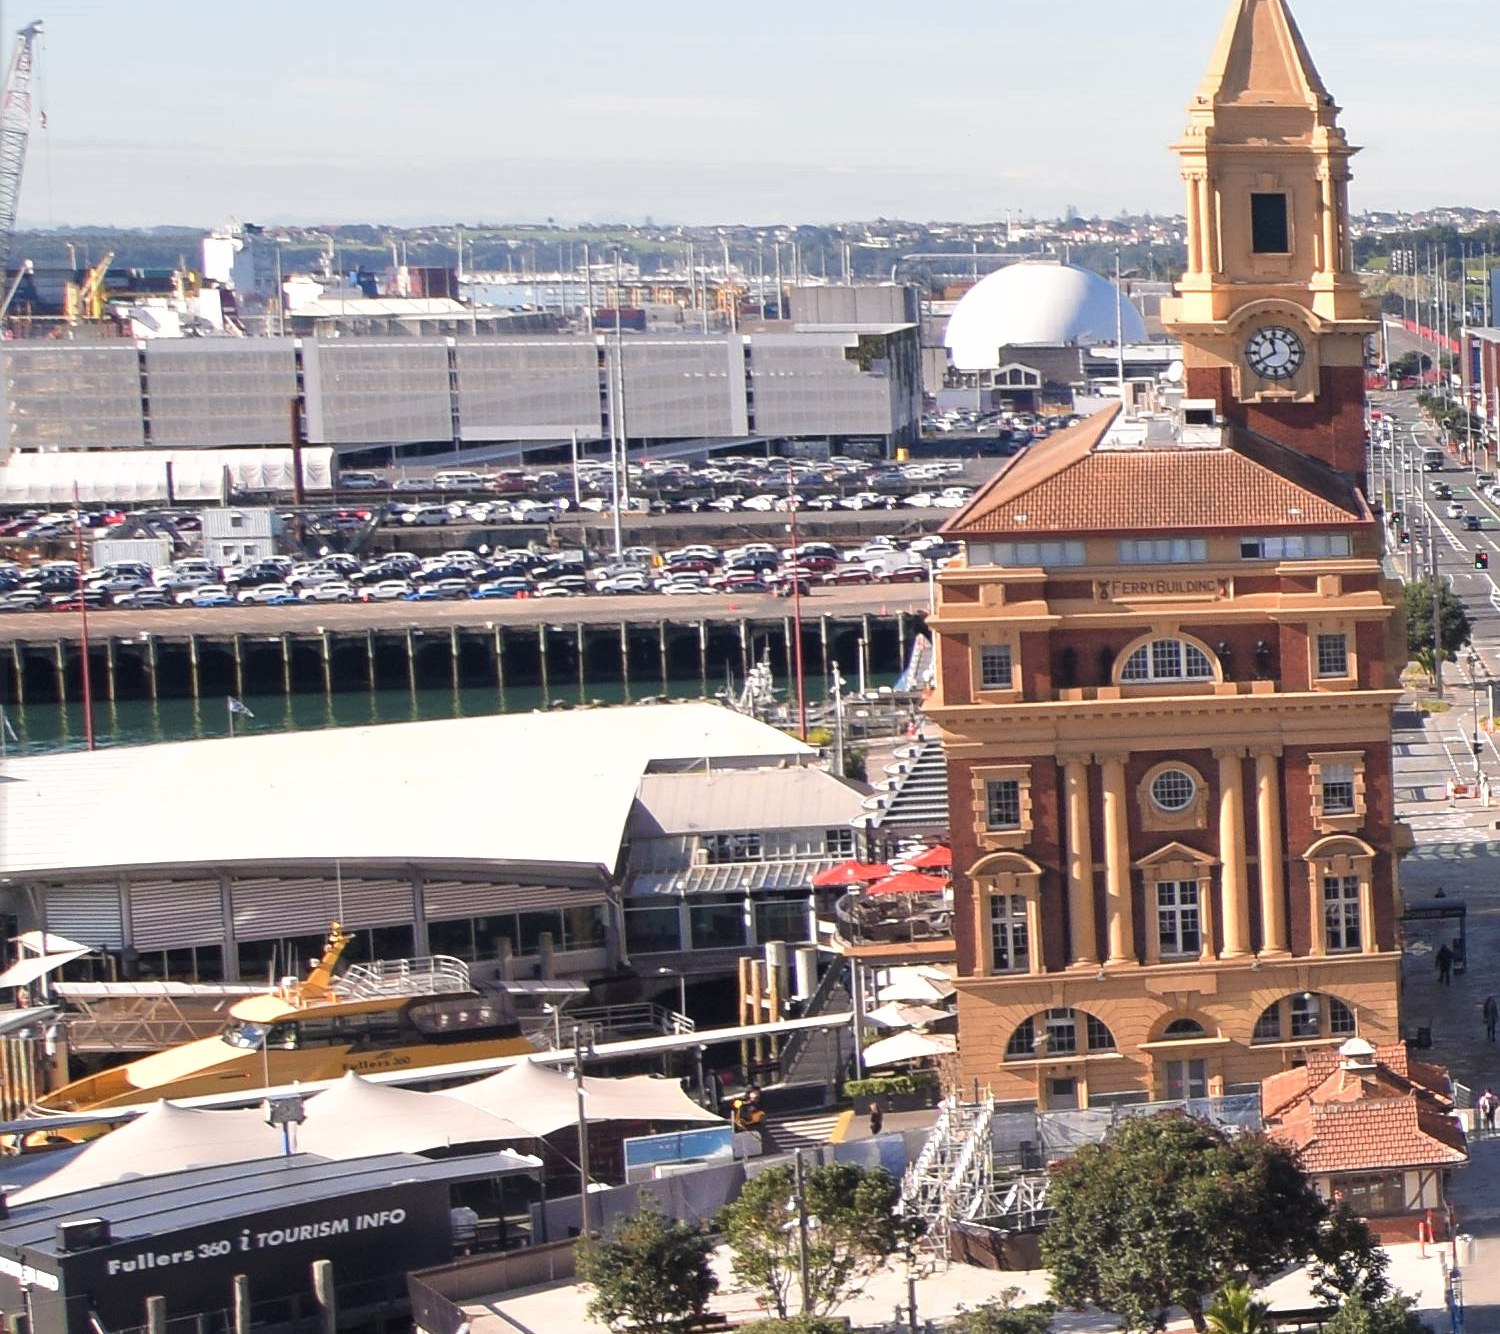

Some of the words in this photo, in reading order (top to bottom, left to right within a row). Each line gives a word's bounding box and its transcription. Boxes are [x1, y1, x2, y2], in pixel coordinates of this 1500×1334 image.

[1111, 580, 1155, 595] FERRY
[1156, 579, 1216, 594] BUILDING
[107, 1248, 196, 1276] Fullers
[198, 1239, 231, 1259] 360
[257, 1218, 349, 1248] TOURISM
[356, 1208, 407, 1231] INFO
